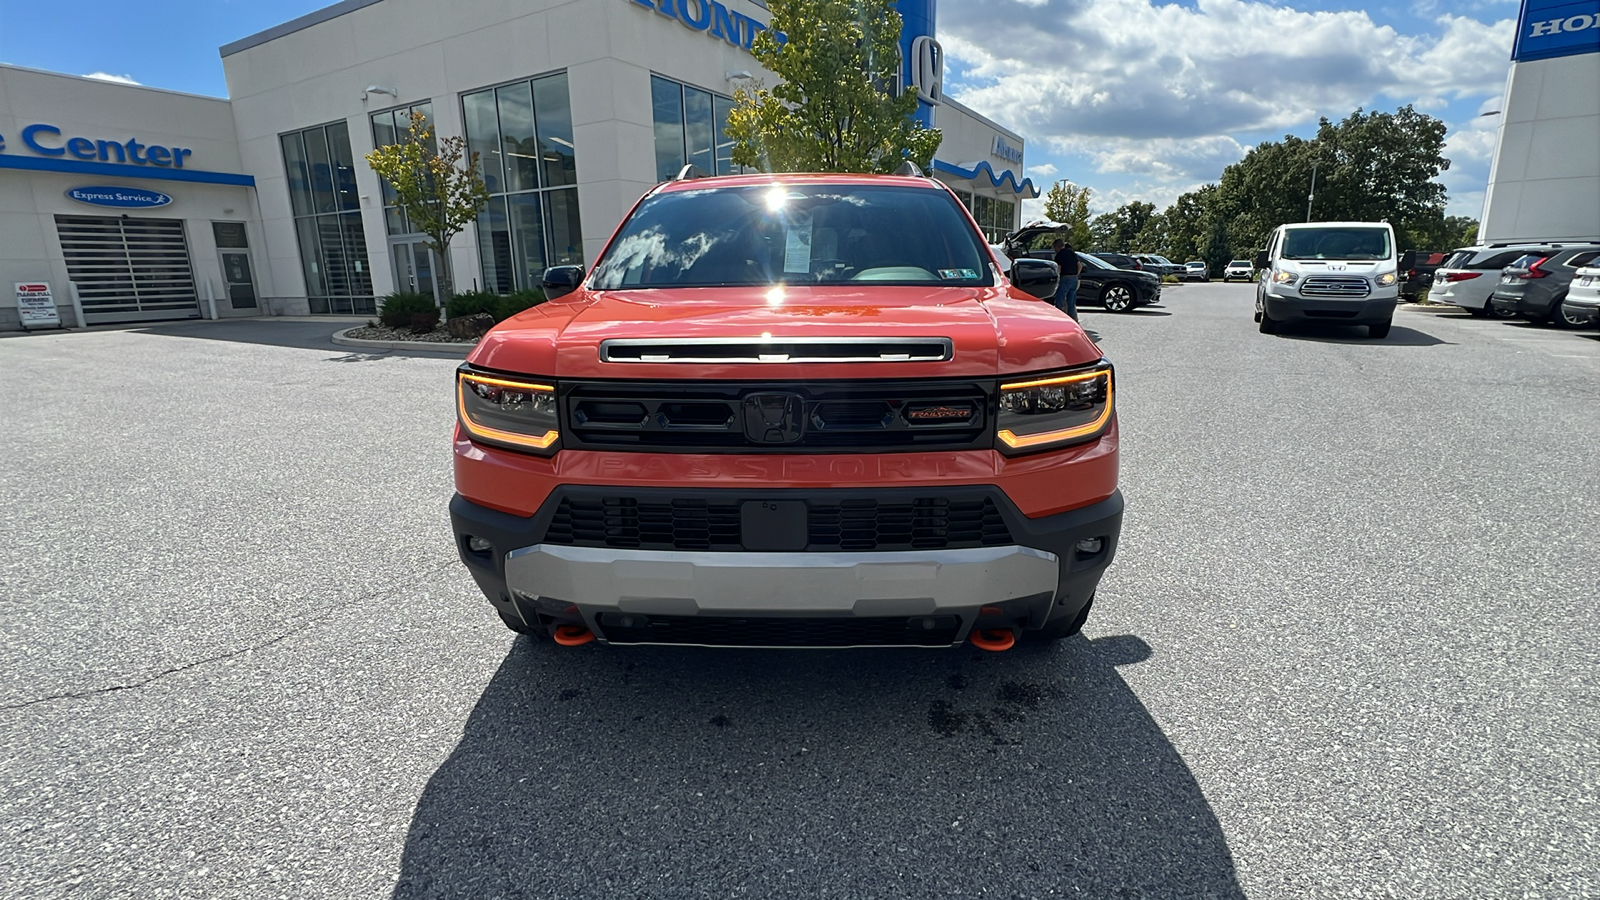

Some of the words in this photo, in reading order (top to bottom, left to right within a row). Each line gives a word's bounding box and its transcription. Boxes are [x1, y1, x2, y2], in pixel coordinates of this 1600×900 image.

[629, 0, 788, 53] OND
[21, 124, 192, 168] Center
[73, 190, 114, 201] Express
[115, 192, 152, 202] Service
[910, 410, 970, 418] TRAILSPORT
[597, 455, 957, 479] PASSPORT
